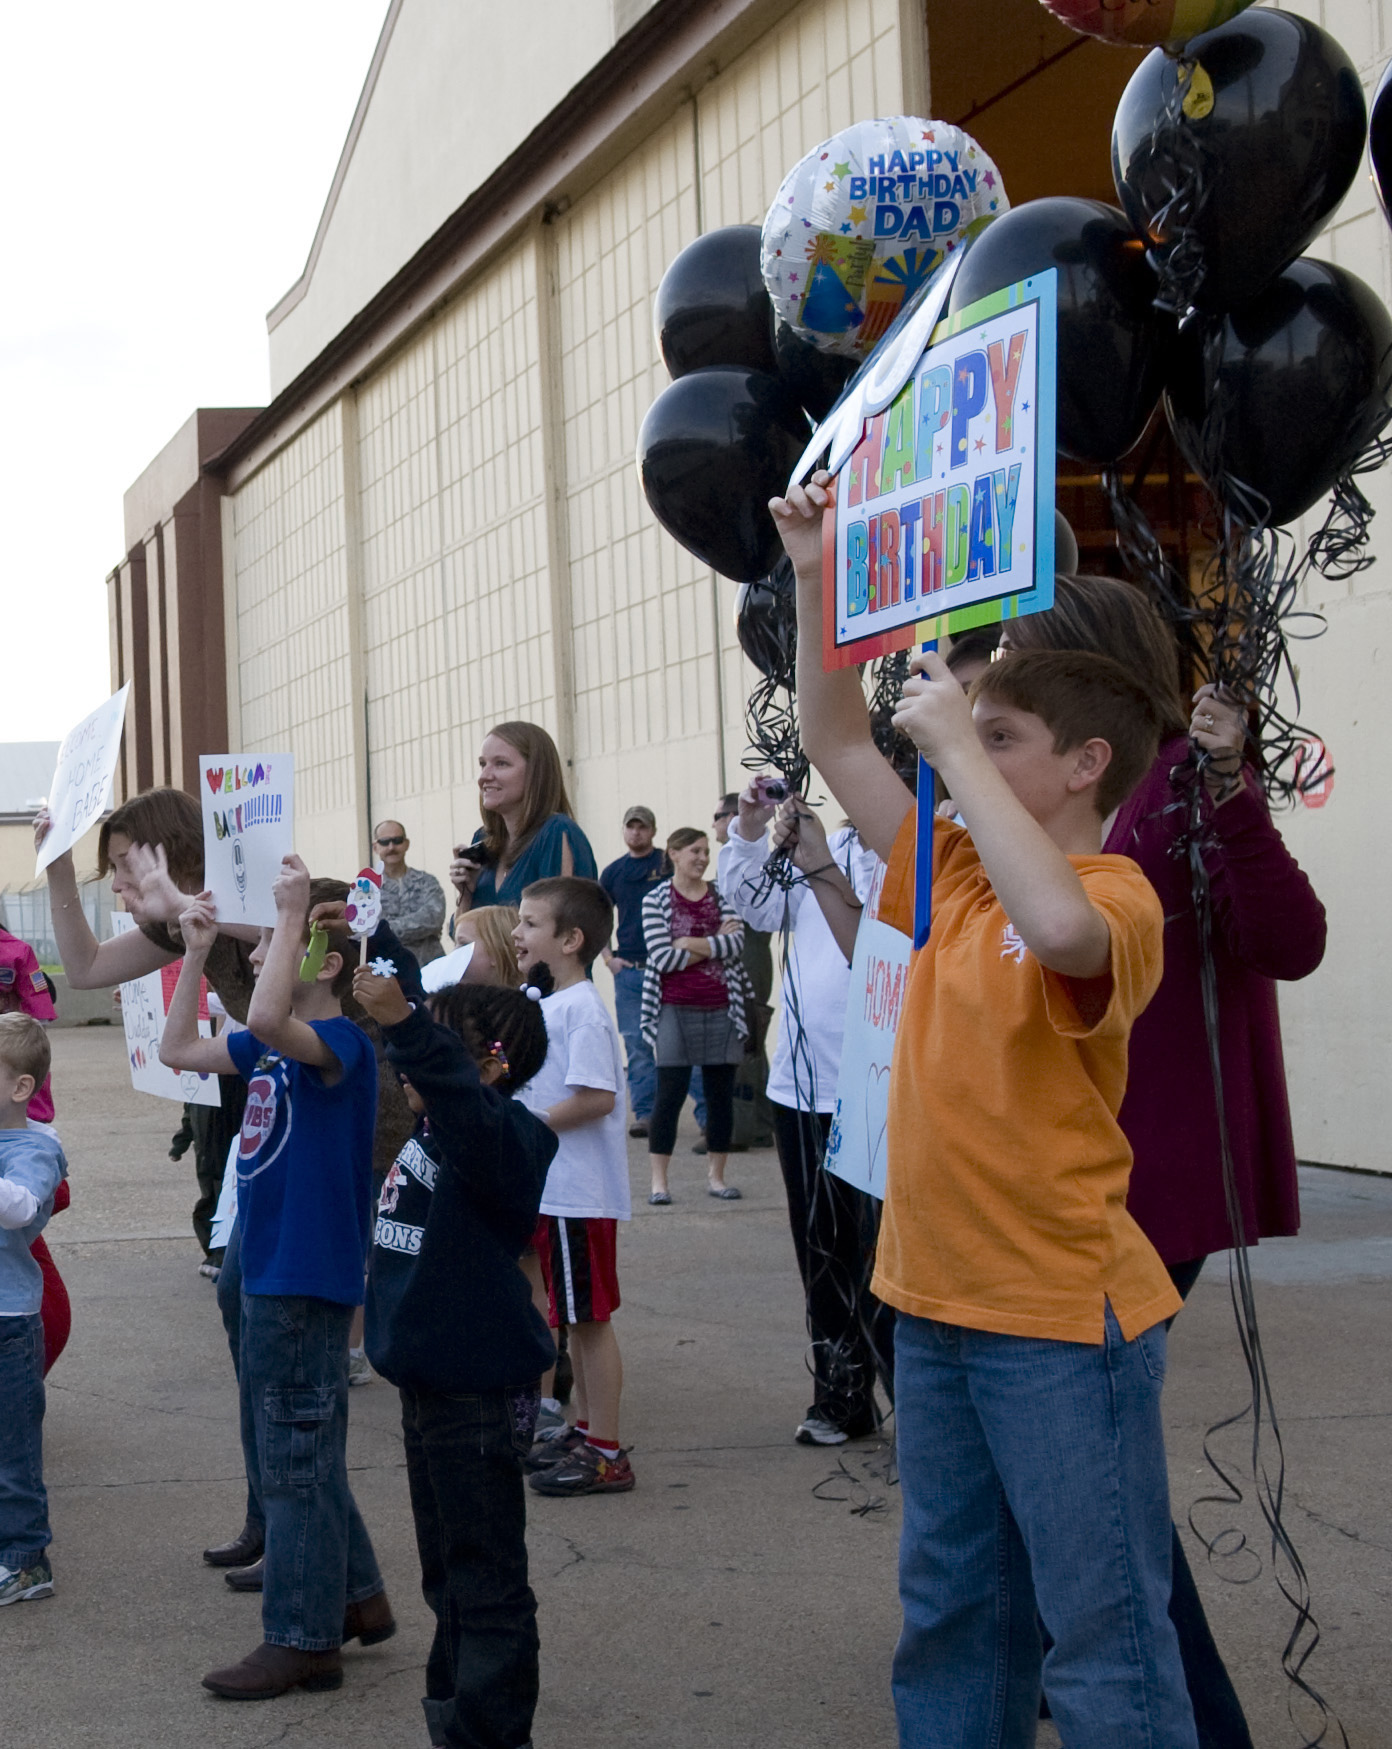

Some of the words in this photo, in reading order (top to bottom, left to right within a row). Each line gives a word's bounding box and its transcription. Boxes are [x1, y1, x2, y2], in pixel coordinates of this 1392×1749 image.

[869, 149, 959, 175] HAPPY
[849, 168, 978, 203] BIRTHDAY
[873, 201, 961, 243] DAD
[848, 329, 1029, 508] HAPPY
[847, 463, 1023, 618] BIRTHDAY
[206, 762, 272, 795] WELCOME
[71, 774, 109, 832] BABE
